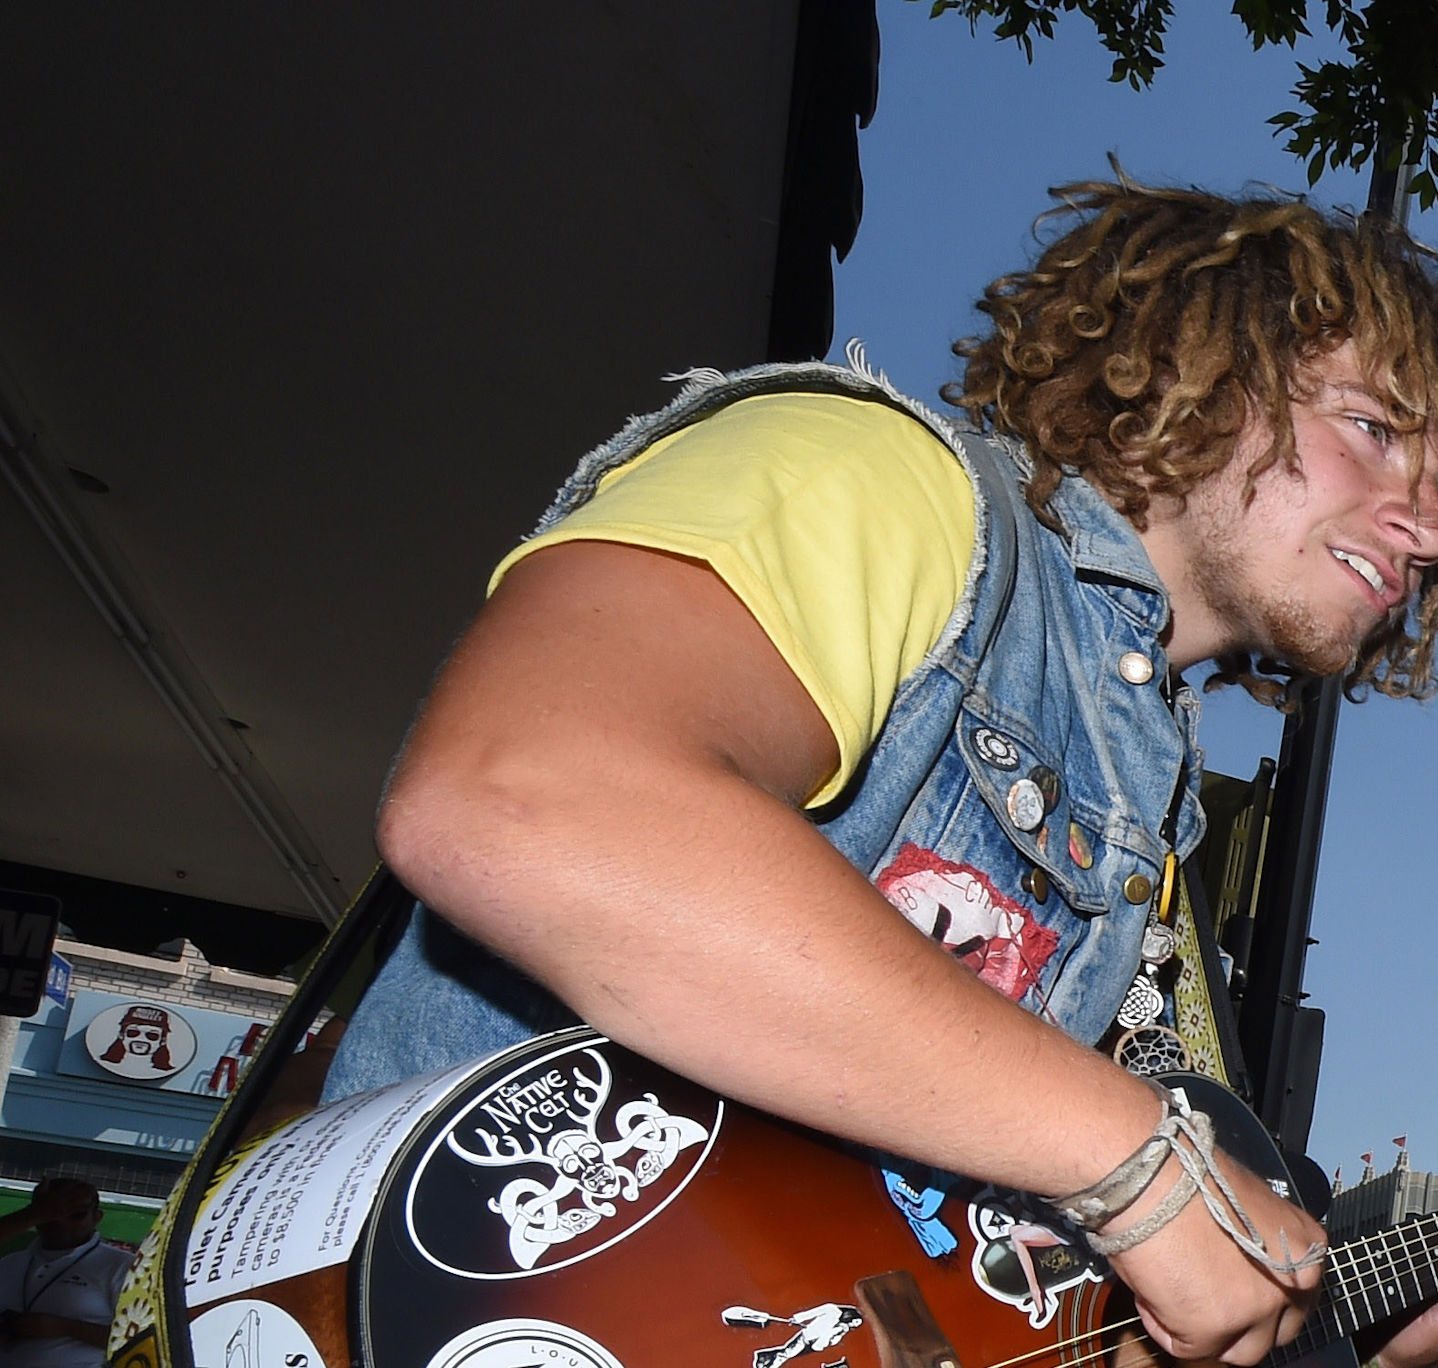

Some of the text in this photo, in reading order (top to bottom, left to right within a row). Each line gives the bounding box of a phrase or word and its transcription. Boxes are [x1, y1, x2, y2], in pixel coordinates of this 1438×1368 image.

[480, 1069, 568, 1133] NATIVE
[525, 1091, 569, 1133] CELT
[210, 1142, 281, 1221] Cameras
[300, 1171, 313, 1190] in
[207, 1186, 258, 1284] purposes
[231, 1190, 278, 1280] Tampering
[252, 1204, 281, 1272] cameras
[273, 1190, 304, 1246] $8,500
[318, 1230, 332, 1252] For
[334, 1206, 350, 1248] please
[347, 1182, 361, 1203] call
[267, 1247, 281, 1267] to
